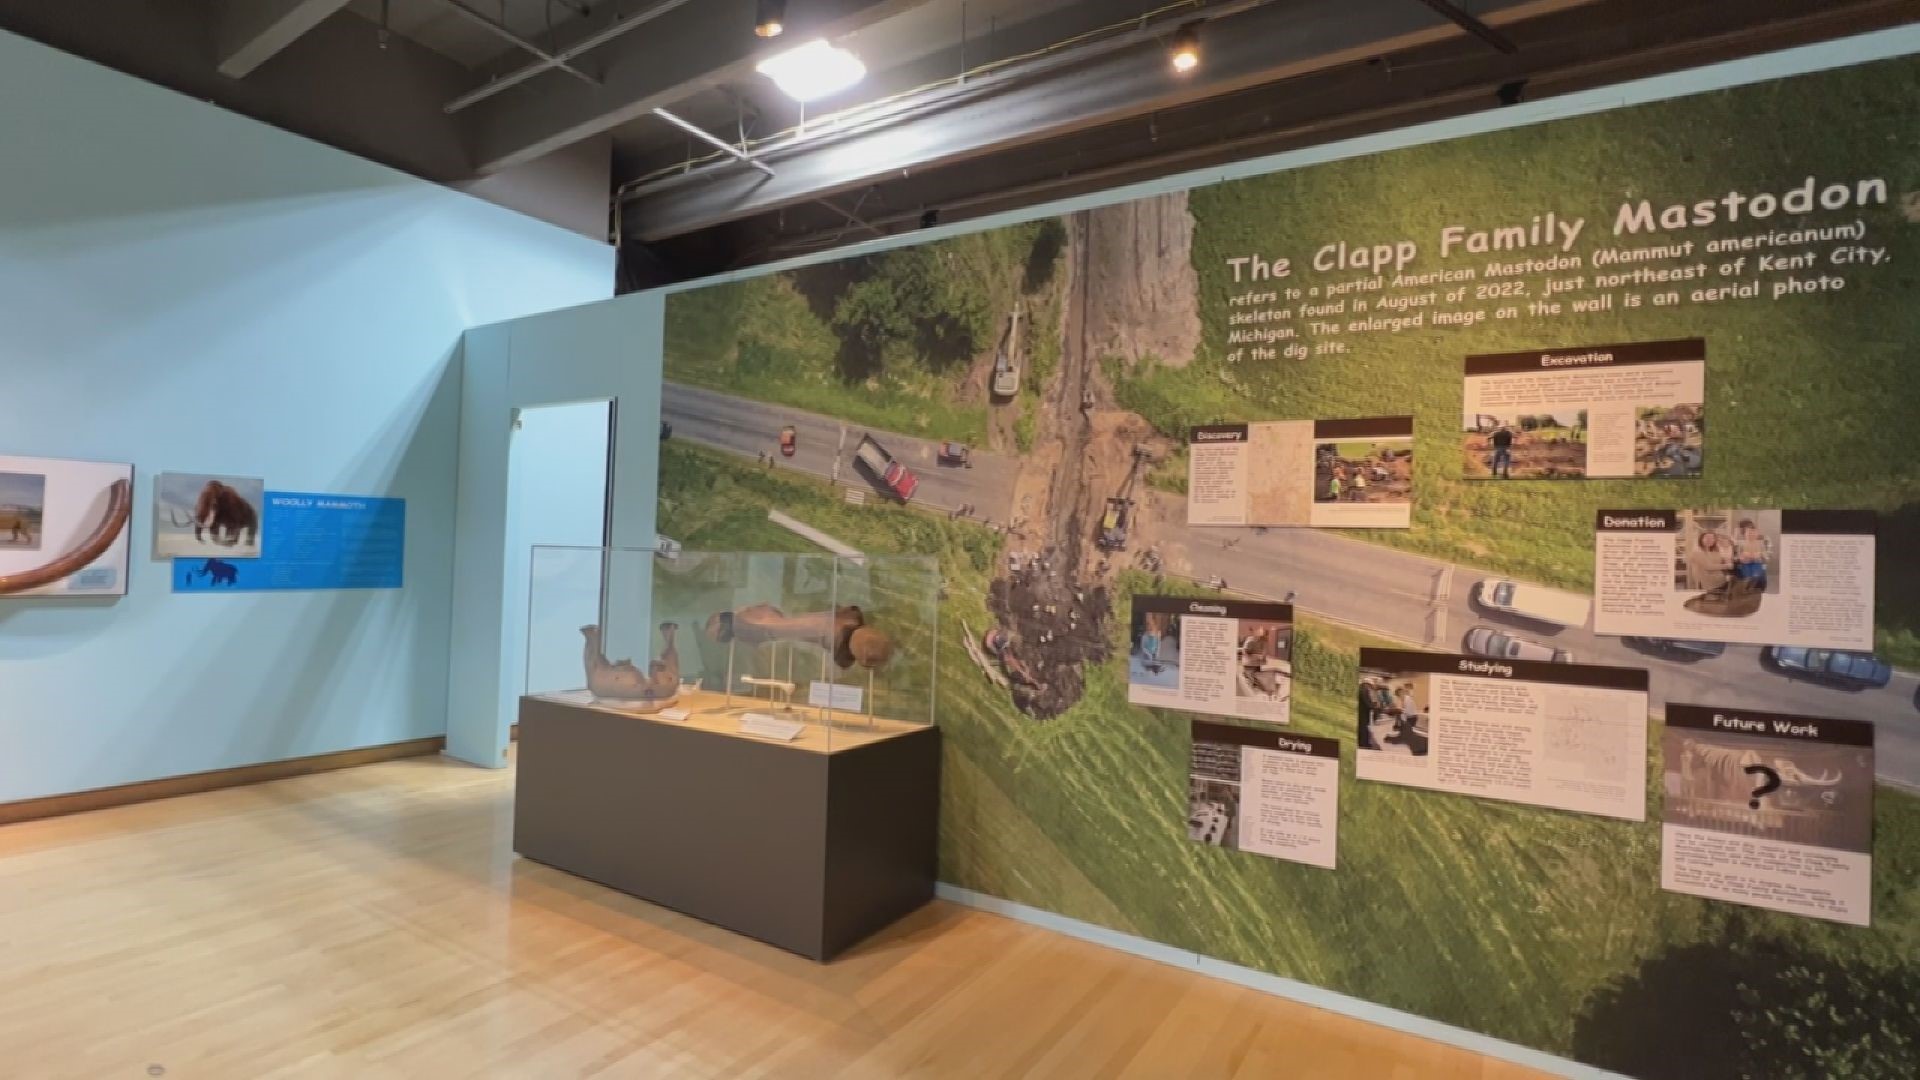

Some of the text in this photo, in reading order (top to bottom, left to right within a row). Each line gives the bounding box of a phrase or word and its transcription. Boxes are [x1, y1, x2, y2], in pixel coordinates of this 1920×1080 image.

[1227, 176, 1887, 283] The Clapp Family Mastodon
[1229, 220, 1867, 307] refers to a partial American Mastodon (Mammut americanum)
[1229, 306, 1291, 326] skeleton
[1300, 301, 1344, 318] found
[1352, 298, 1367, 313] in
[1376, 291, 1436, 316] August
[1446, 286, 1466, 303] of
[1543, 275, 1585, 297] just
[1595, 262, 1708, 289] northeast
[1719, 257, 1747, 276] of
[1759, 251, 1817, 272] Kent
[1227, 274, 1846, 344] Michigan. The enlarged image on the wall is an aerial photo
[1226, 341, 1351, 363] of the dig site.
[1541, 351, 1614, 367] Excavation
[1603, 515, 1666, 529] Donation
[1458, 659, 1513, 678] Studying
[1713, 714, 1819, 737] Future Work
